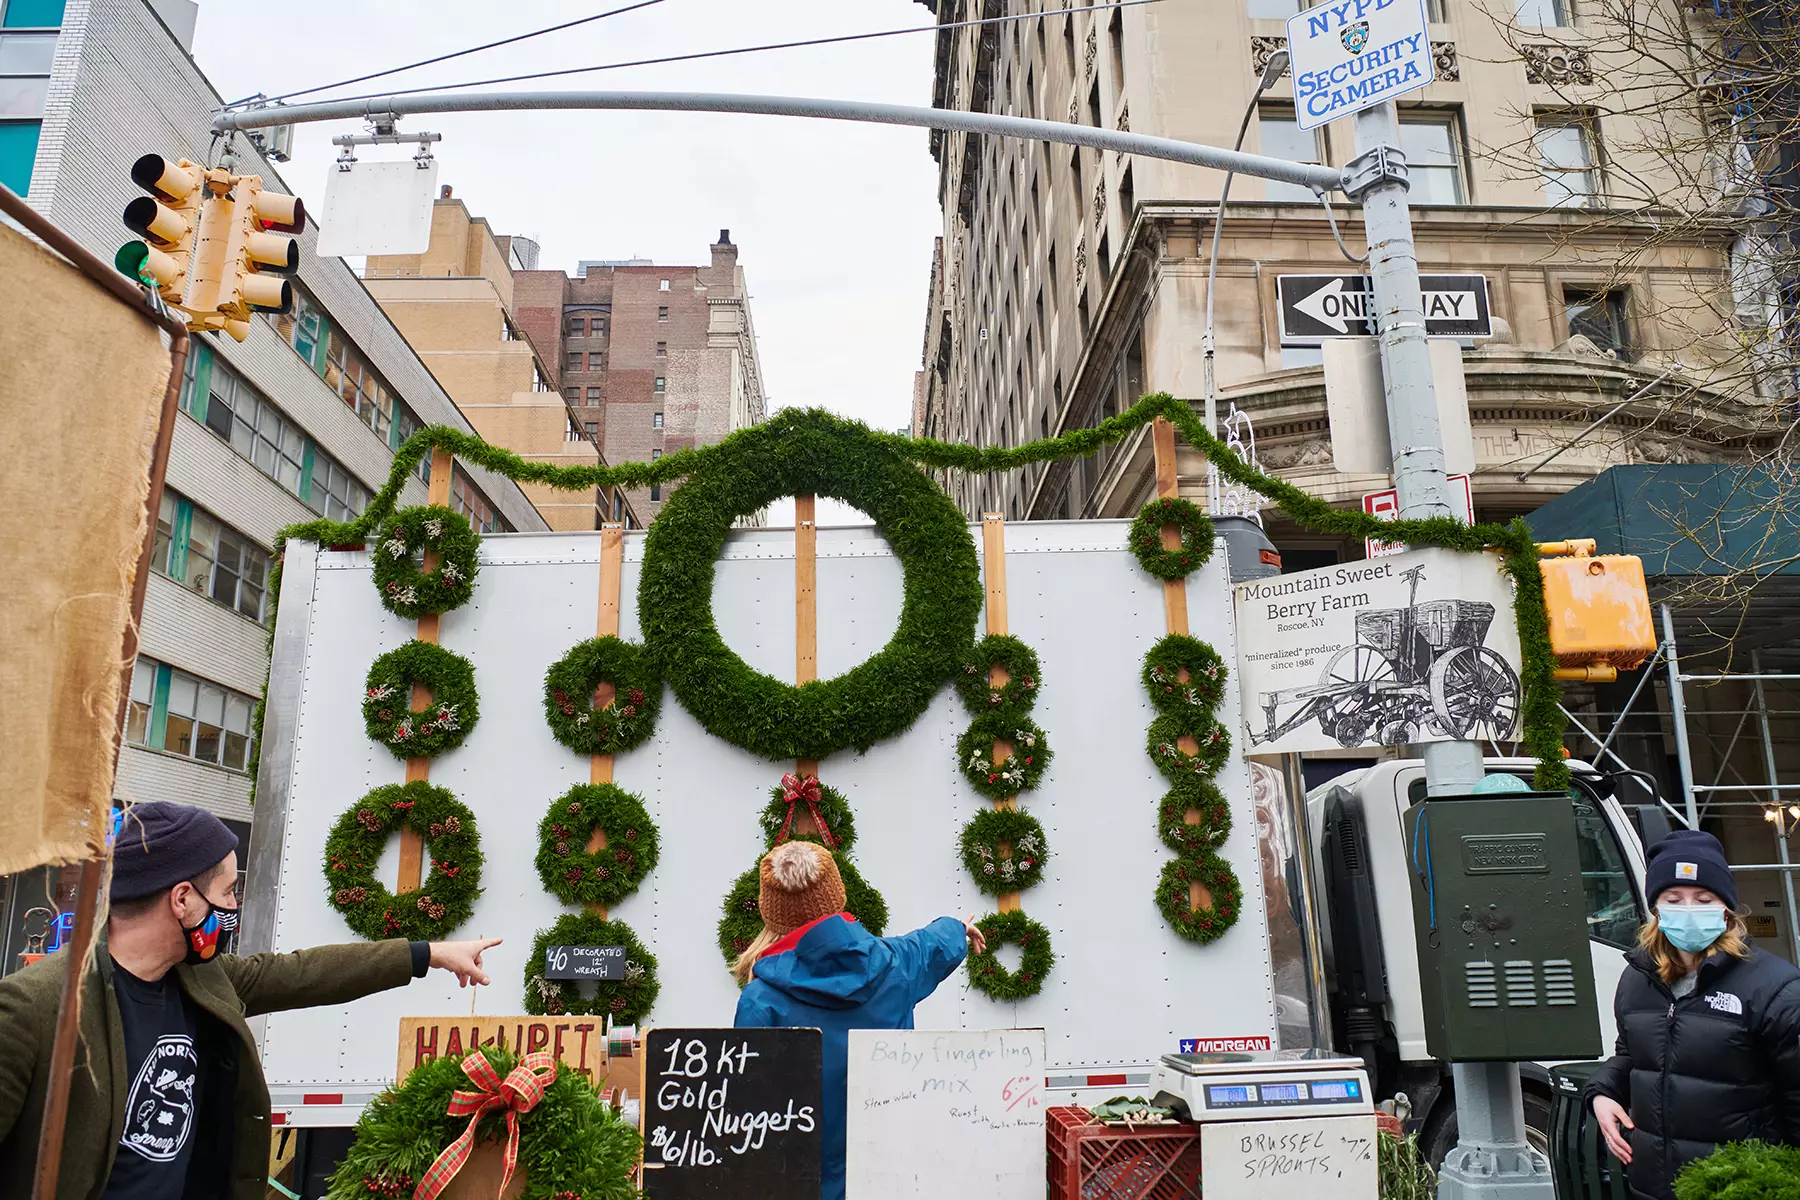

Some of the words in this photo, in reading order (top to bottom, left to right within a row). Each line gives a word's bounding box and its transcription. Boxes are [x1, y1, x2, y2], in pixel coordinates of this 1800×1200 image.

[1298, 32, 1422, 97] SECURITY
[1307, 60, 1421, 116] CAMERA
[1421, 294, 1465, 317] AY
[1479, 436, 1513, 458] THE
[1244, 574, 1330, 602] Mountain
[1336, 563, 1393, 586] Sweet
[1267, 601, 1317, 620] Berry
[1321, 592, 1370, 612] Farm
[1277, 622, 1310, 633] Roscoe,
[1311, 617, 1325, 627] NY
[1304, 643, 1342, 656] produce
[1270, 662, 1294, 670] since
[1295, 658, 1315, 668] 1986
[1469, 844, 1503, 853] TRAFFIC
[1504, 843, 1543, 852] CONTROL
[1474, 855, 1493, 864] NEW
[1494, 855, 1517, 864] YORK
[1518, 854, 1538, 863] CITY
[573, 948, 623, 957] DECORATED
[574, 965, 608, 977] WREATH
[157, 1044, 190, 1059] NORT
[1197, 1039, 1267, 1053] MORGAN
[660, 1038, 709, 1077] 18
[871, 1041, 924, 1072] Baby
[922, 1077, 973, 1093] mix
[657, 1078, 729, 1111] Gold
[864, 1097, 890, 1110] Steam
[894, 1092, 917, 1104] whole
[701, 1098, 816, 1155] Nuggets
